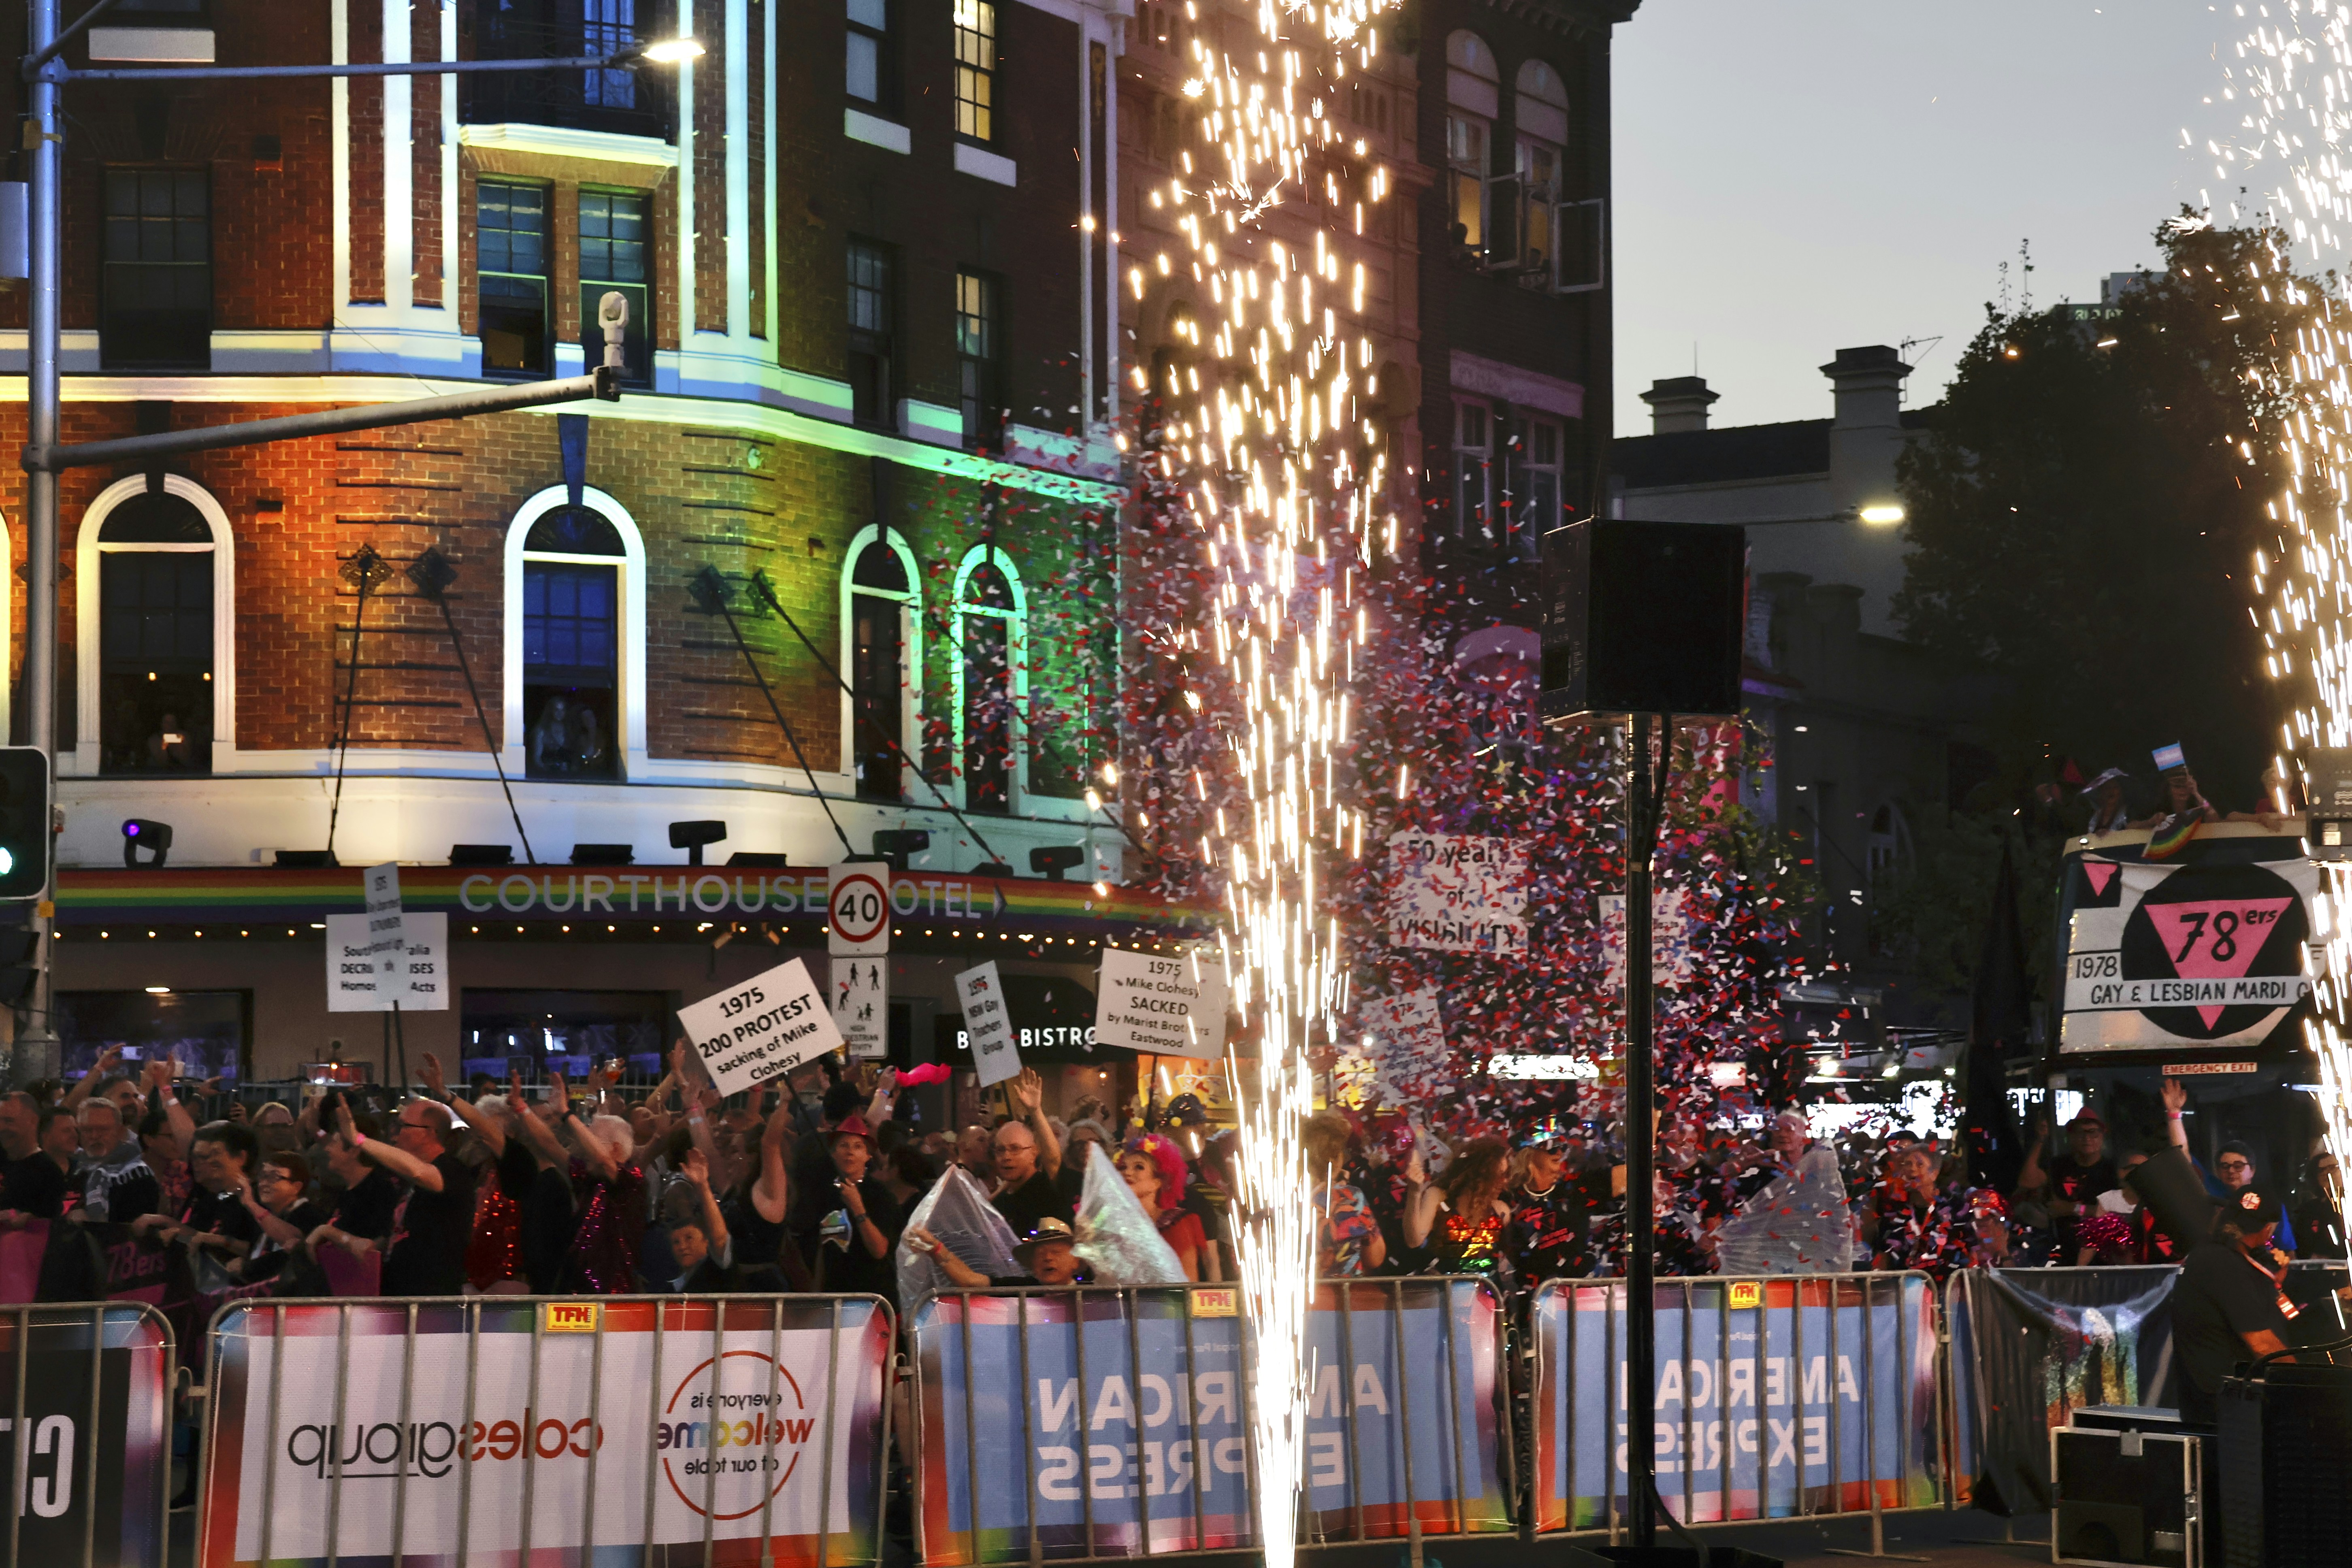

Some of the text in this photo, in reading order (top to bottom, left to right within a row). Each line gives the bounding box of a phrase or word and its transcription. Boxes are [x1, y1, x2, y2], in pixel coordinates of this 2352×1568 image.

[1408, 839, 1436, 863] 0
[460, 873, 982, 919] COURTHOUSE OTEL
[838, 894, 879, 923] 40
[1398, 918, 1518, 948] VISIBIITY
[1148, 961, 1182, 977] 1975
[2075, 955, 2119, 979] 1978
[411, 982, 436, 993] Acts
[1126, 977, 1199, 999] Mike Clohesy
[2091, 984, 2124, 1005] GAY
[2150, 981, 2226, 1002] LESBIAN
[2233, 981, 2287, 1000] MARDI
[719, 986, 765, 1018] 1975
[1130, 996, 1189, 1016] SACKED
[699, 993, 812, 1059] 200 PROTEST
[1107, 1012, 1210, 1036] by Marist Broters
[717, 1022, 818, 1074] sacking of Mike
[1020, 1027, 1098, 1048] BISTRO
[1131, 1031, 1185, 1048] Eastwood
[750, 1051, 801, 1080] Clohesy
[2164, 1063, 2255, 1074] EMERGENCY EXIT
[1197, 1292, 1229, 1306] TFH
[554, 1306, 589, 1322] TFH
